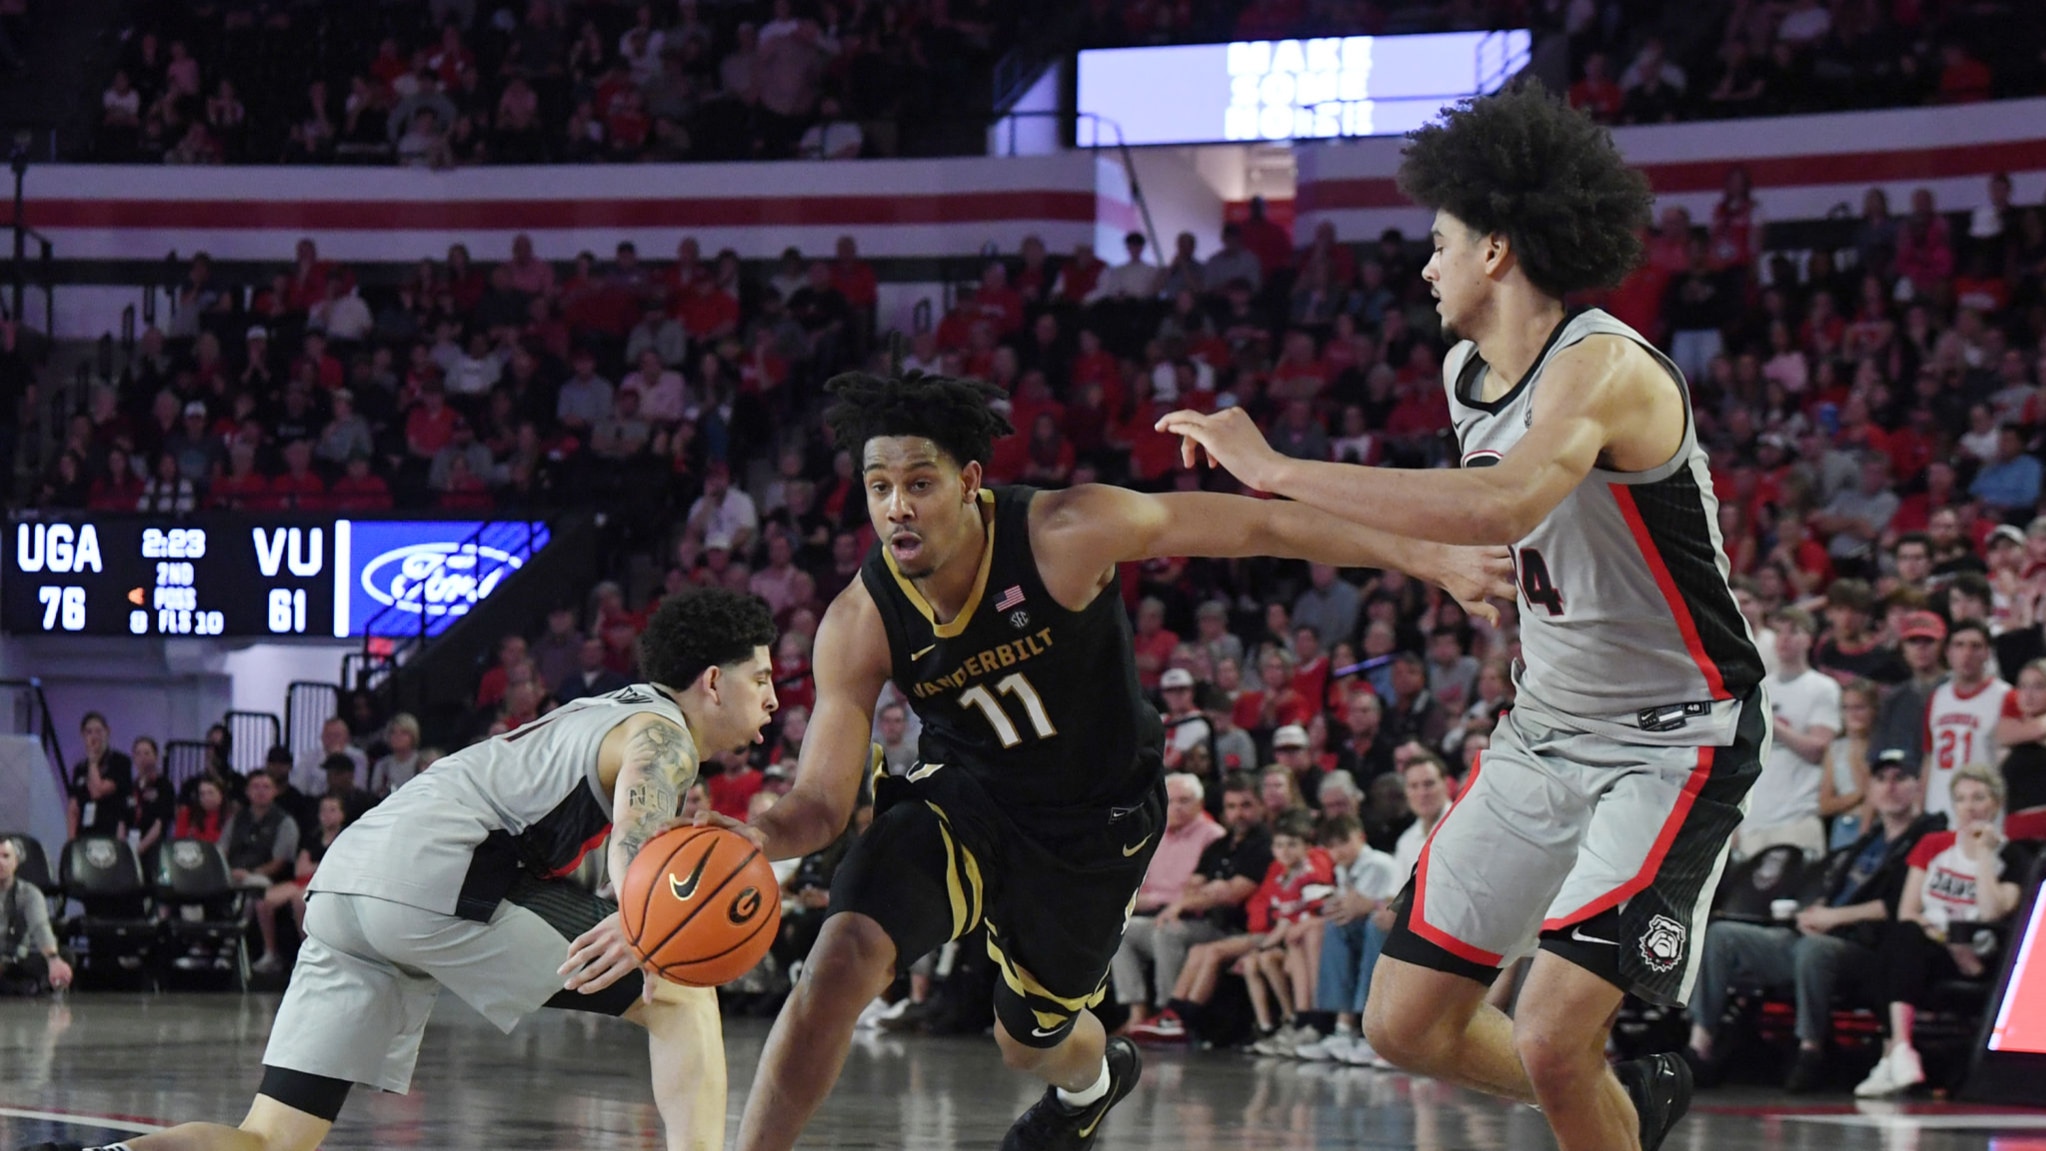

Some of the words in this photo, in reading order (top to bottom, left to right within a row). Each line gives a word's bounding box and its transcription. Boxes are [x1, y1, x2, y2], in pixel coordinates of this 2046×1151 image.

[1227, 36, 1374, 75] MAKE
[1230, 70, 1369, 106] SOME
[17, 523, 102, 573] UGA
[142, 528, 206, 558] 2:23
[252, 527, 323, 577] VU
[156, 562, 194, 586] 2ND
[38, 586, 86, 631] 76
[194, 611, 224, 635] 10
[267, 588, 307, 633] 61
[1010, 611, 1029, 628] SEC
[913, 627, 1053, 698] VANDERBILT
[958, 672, 1057, 748] 11
[1938, 729, 1973, 769] 21
[728, 887, 762, 926] G
